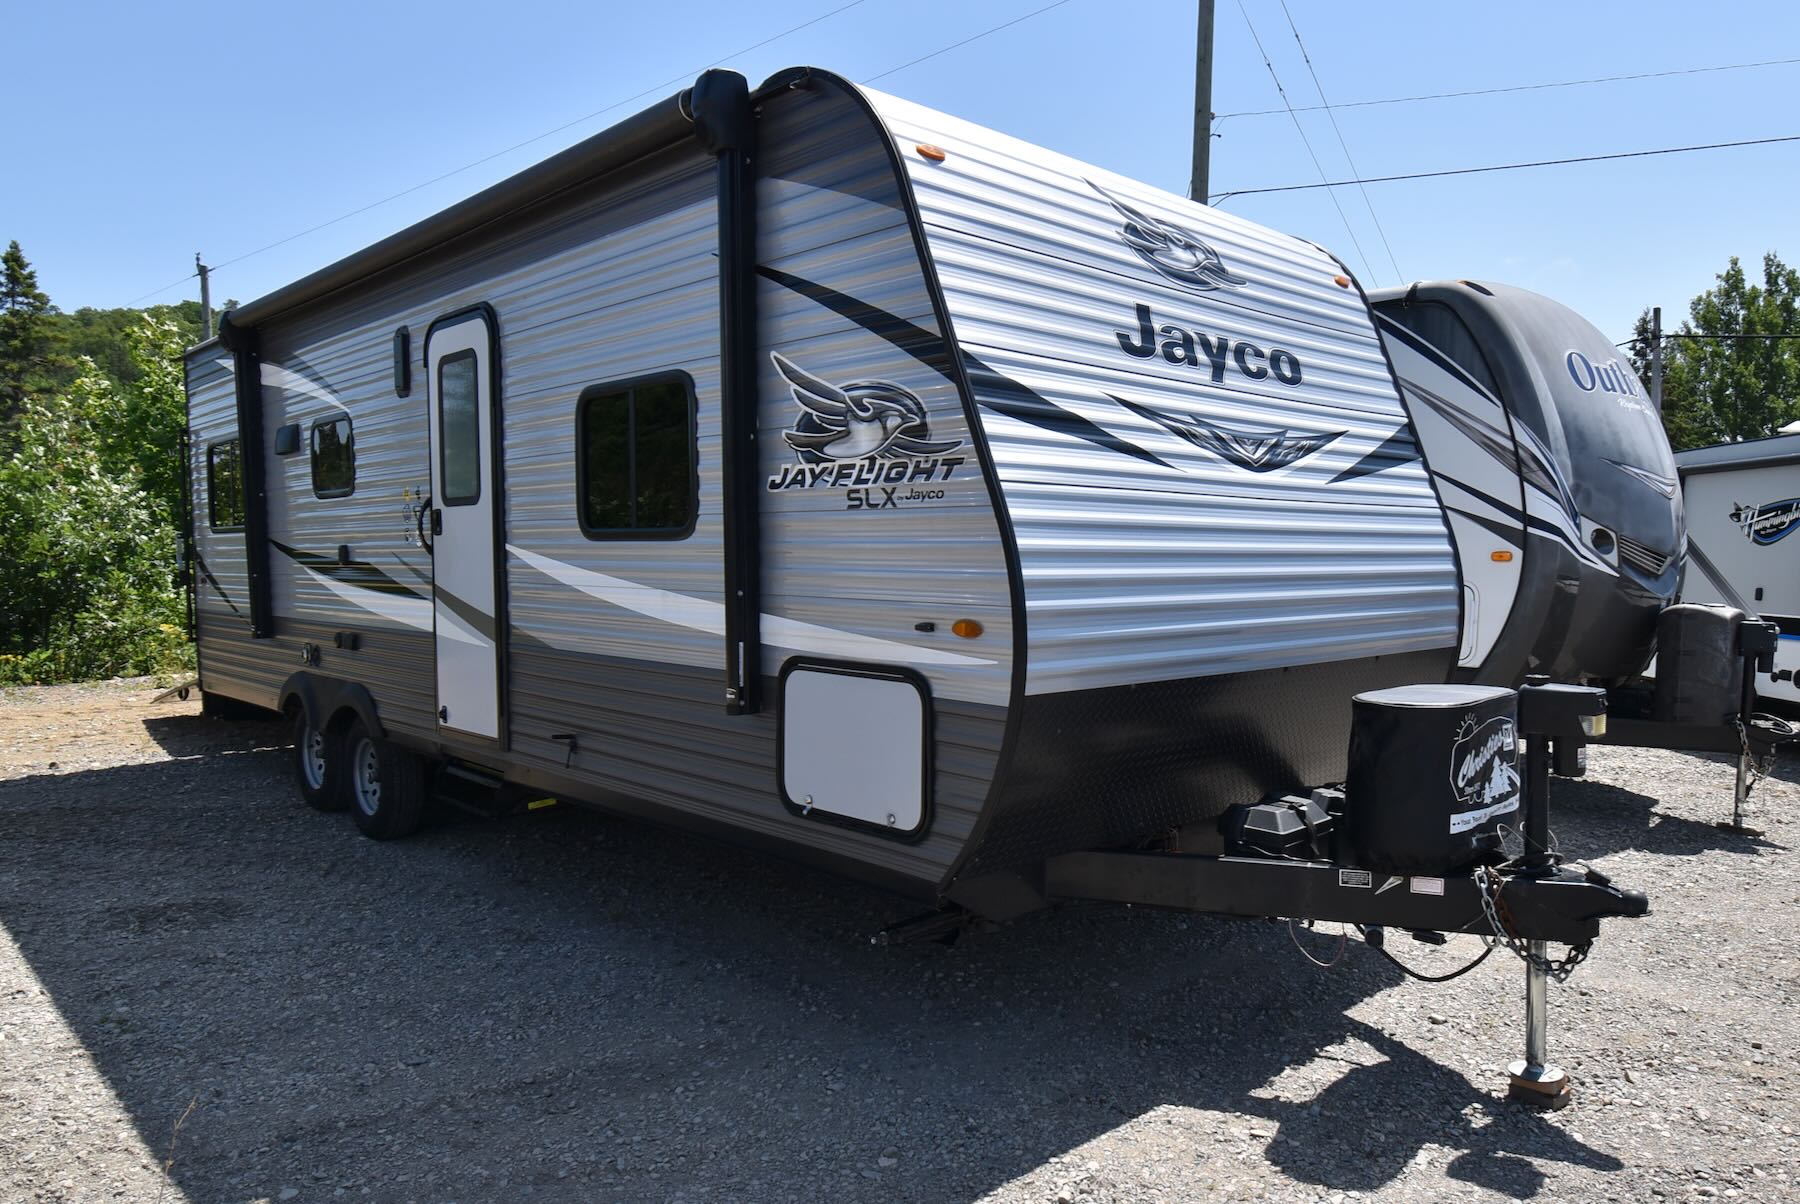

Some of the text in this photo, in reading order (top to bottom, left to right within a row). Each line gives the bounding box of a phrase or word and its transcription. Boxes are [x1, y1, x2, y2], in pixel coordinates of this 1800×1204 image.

[1114, 302, 1303, 386] Jayco
[847, 487, 897, 509] SLX
[905, 488, 945, 502] Jayco
